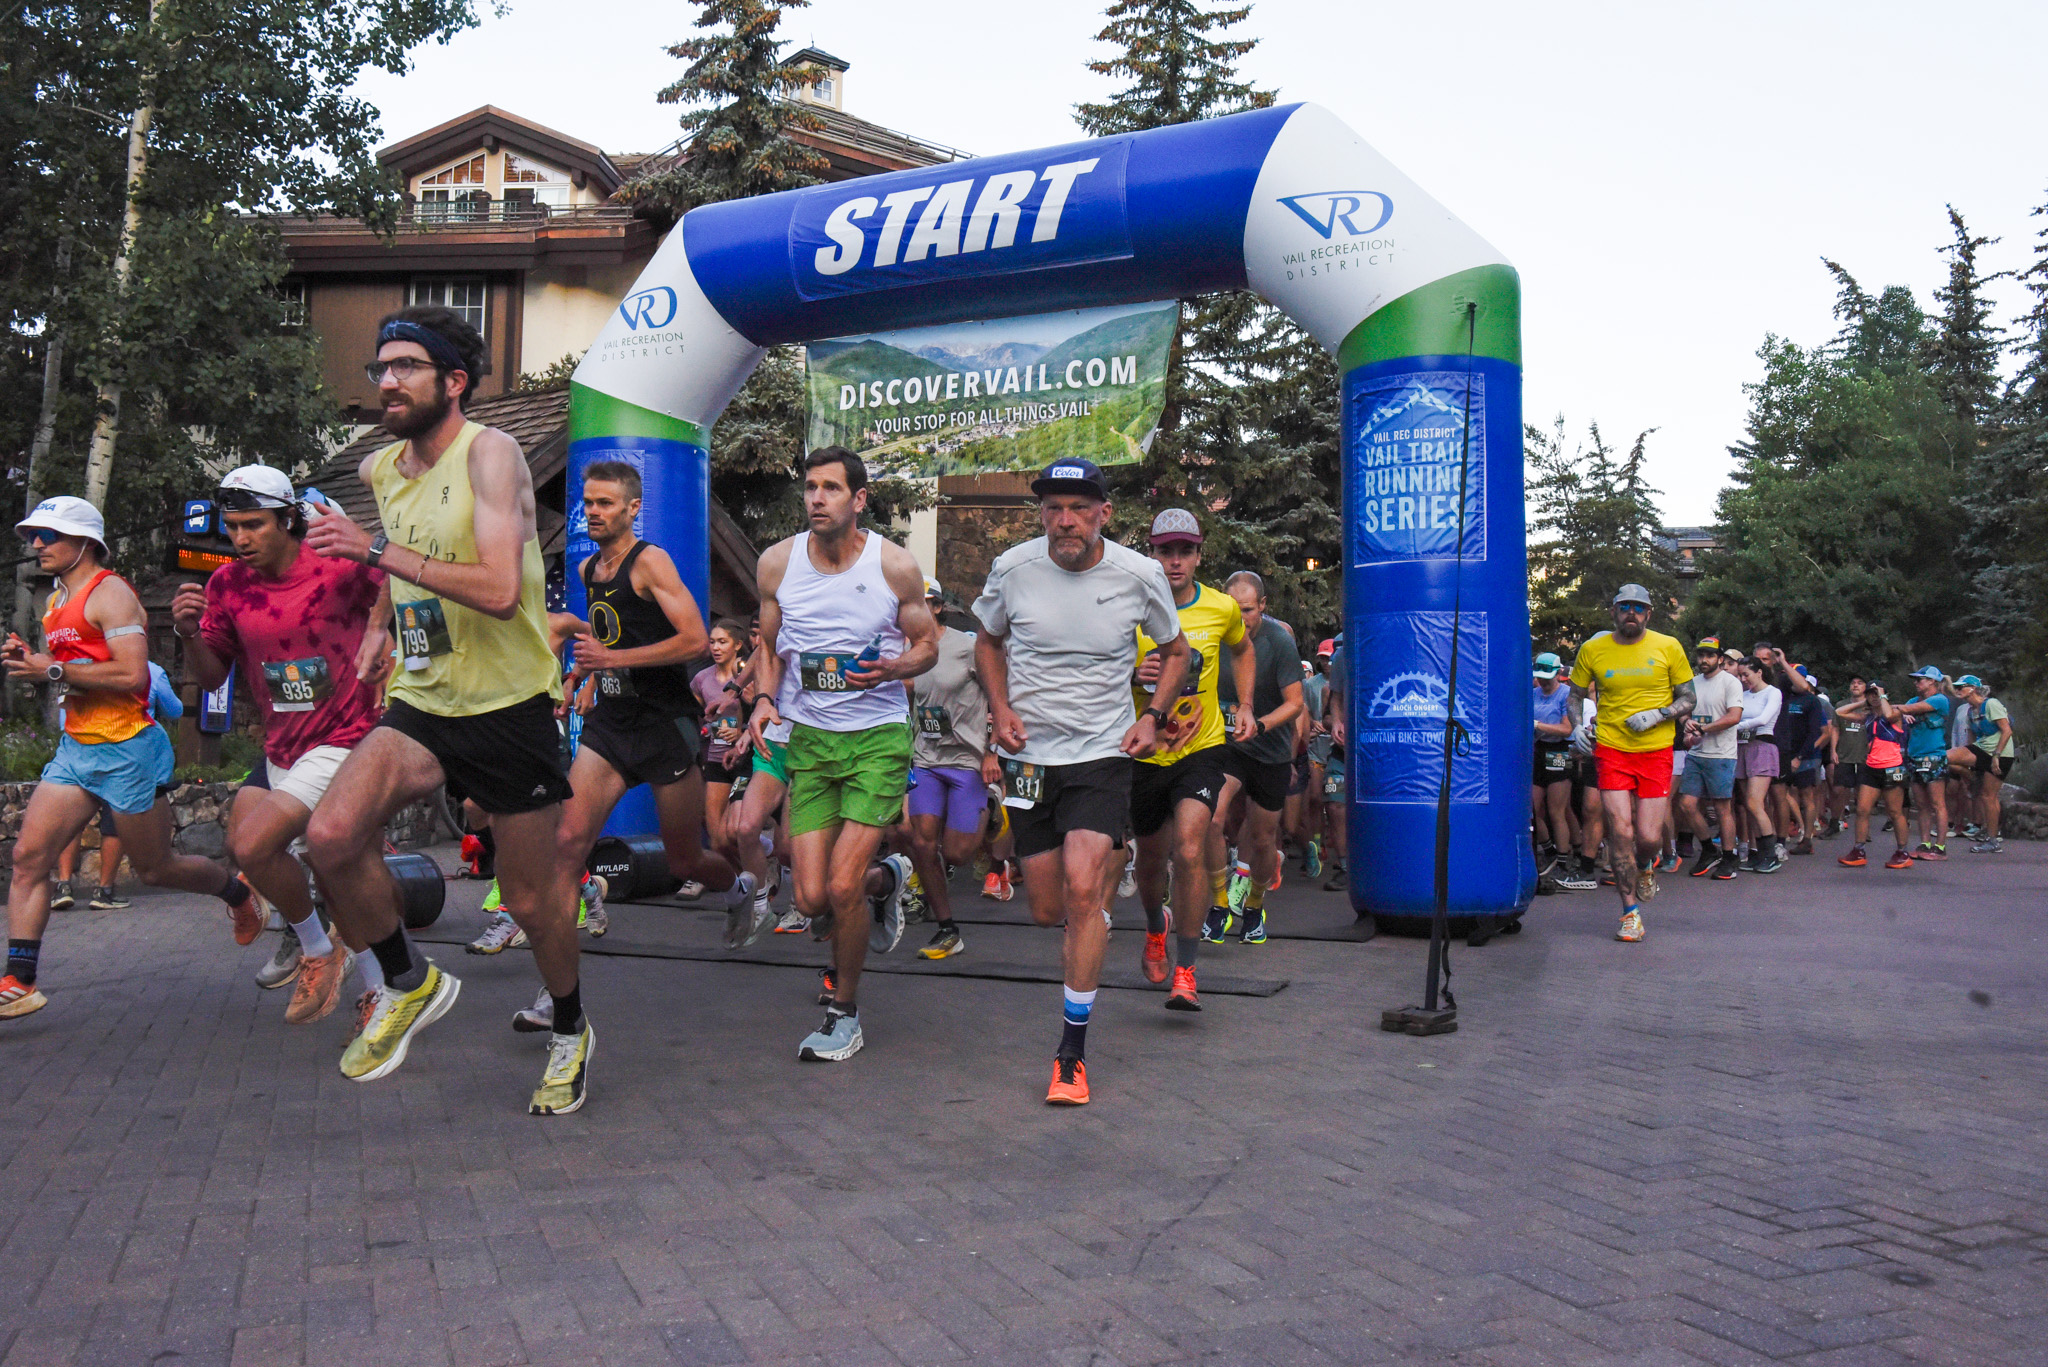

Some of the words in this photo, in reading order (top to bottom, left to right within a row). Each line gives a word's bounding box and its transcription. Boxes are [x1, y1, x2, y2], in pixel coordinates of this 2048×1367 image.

[814, 157, 1100, 275] START
[1283, 252, 1306, 265] VAIL
[1310, 239, 1395, 260] RECREATION
[1287, 253, 1394, 281] DISTRICT
[603, 340, 619, 350] VAIL
[622, 332, 683, 347] RECREATION
[601, 345, 685, 362] DISTRICT
[839, 355, 1136, 410] DISCOVERVAIL.COM
[875, 417, 911, 434] YOUR
[914, 414, 946, 431] STOP
[951, 410, 975, 428] FOR
[979, 408, 1003, 425] ALL
[1005, 402, 1056, 423] THINGS
[1059, 401, 1091, 418] VAIL
[1373, 432, 1390, 443] VAIL
[1393, 429, 1410, 440] REC
[1413, 428, 1456, 439] DISTRICT
[1365, 444, 1402, 467] VAIL
[1408, 442, 1464, 463] TRAIL
[1054, 468, 1081, 477] Color
[1365, 495, 1466, 533] SERIES
[402, 628, 429, 655] 799
[282, 680, 314, 700] 935
[601, 678, 621, 694] 863
[818, 671, 846, 689] 685
[924, 719, 940, 731] 879
[1360, 731, 1396, 743] MOUNTAIN
[1399, 731, 1418, 743] BIKE
[1016, 776, 1040, 798] 811
[596, 863, 629, 873] MYLAPS
